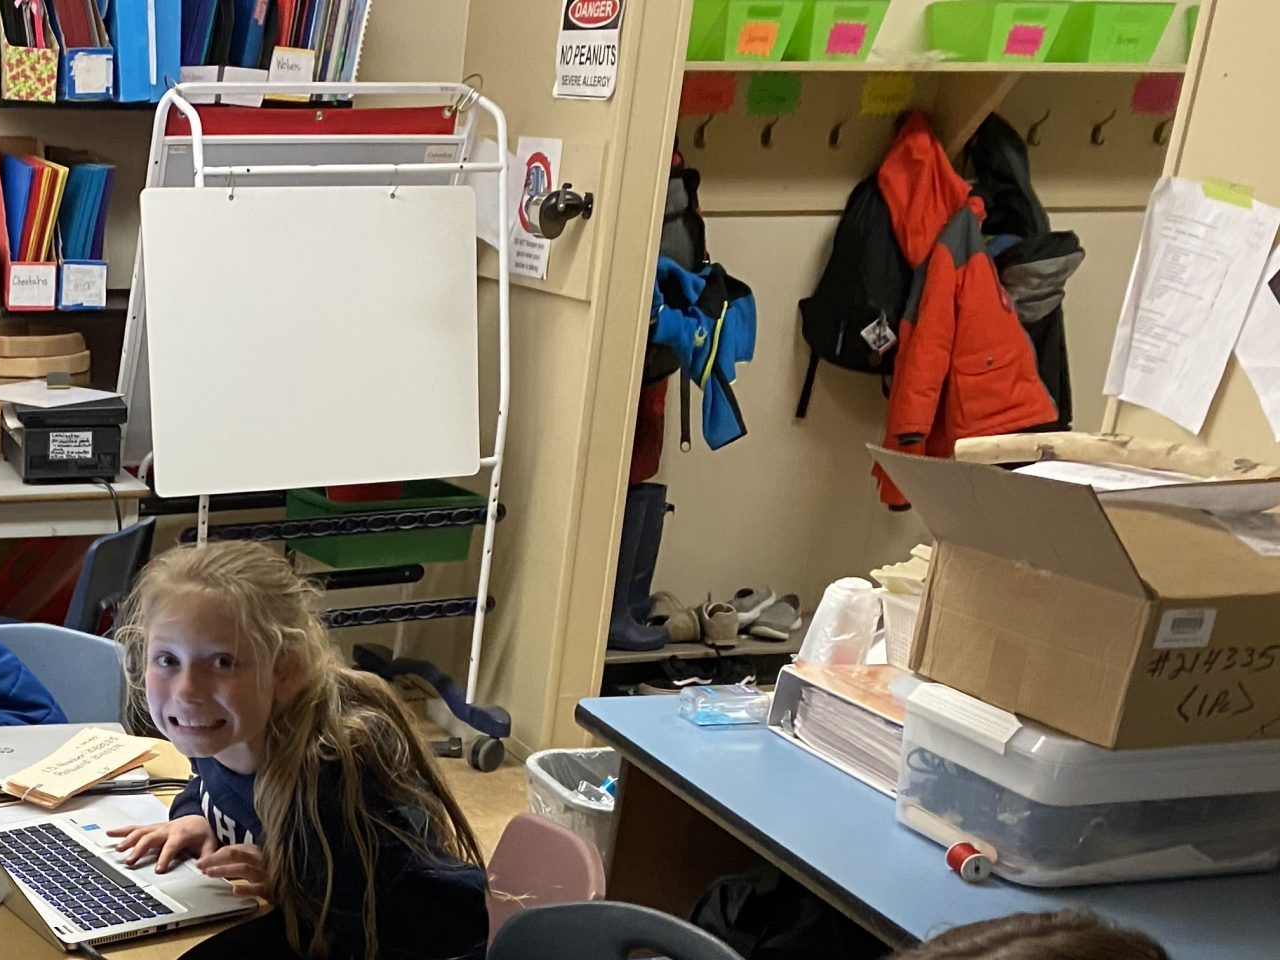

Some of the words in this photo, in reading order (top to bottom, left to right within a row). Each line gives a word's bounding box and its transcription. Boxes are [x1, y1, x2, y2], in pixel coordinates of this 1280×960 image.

[575, 1, 612, 18] DANGER
[560, 45, 572, 66] NO
[574, 45, 616, 66] PEANUTS
[276, 57, 300, 71] Wolves
[561, 75, 581, 86] SEVERE
[583, 75, 610, 87] ALLERGY
